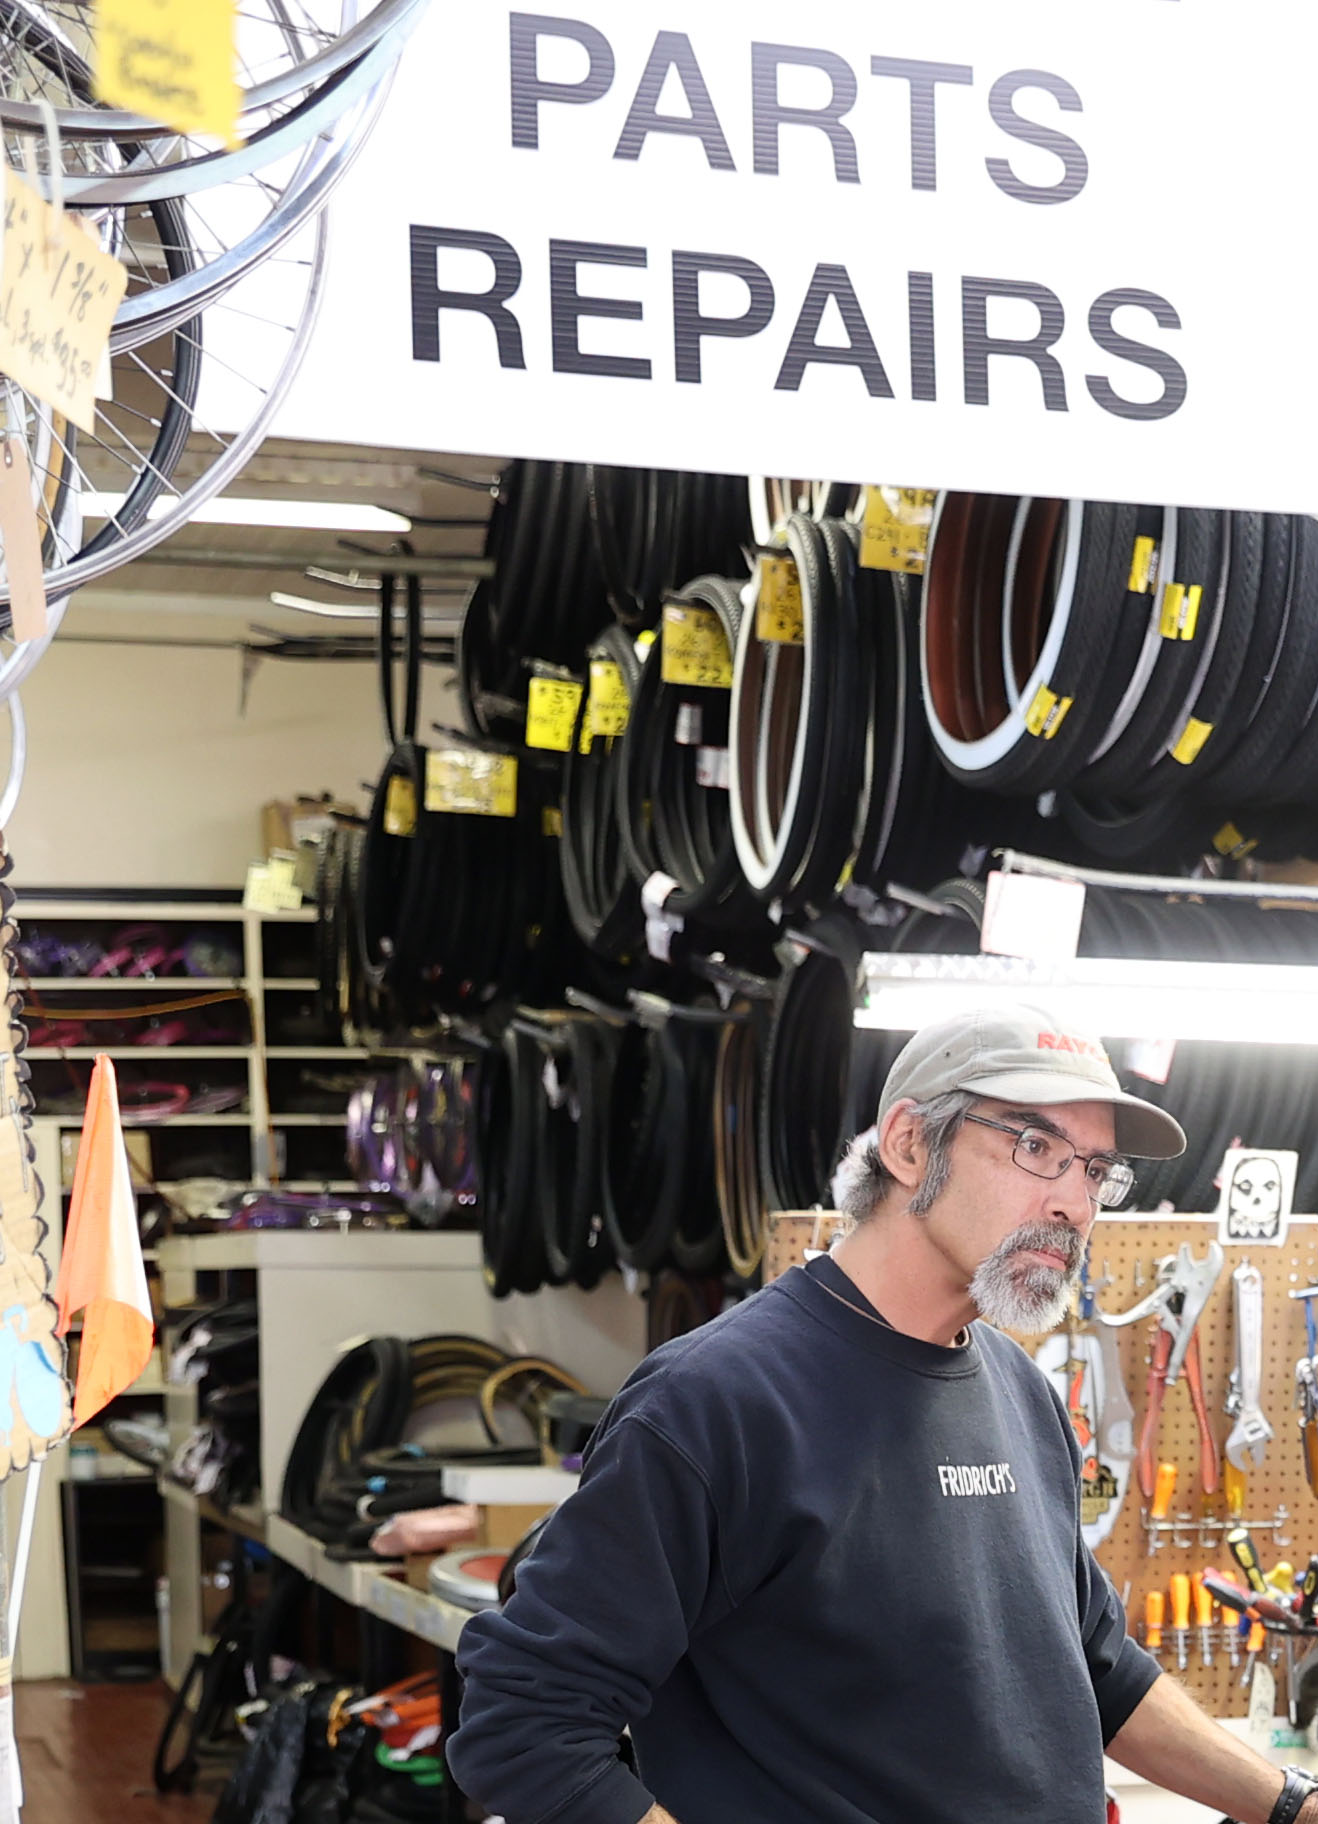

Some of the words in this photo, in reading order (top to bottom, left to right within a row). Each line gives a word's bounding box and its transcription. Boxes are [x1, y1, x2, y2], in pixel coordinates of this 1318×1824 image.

[508, 11, 1090, 206] PARTS
[409, 224, 1189, 422] REPAIRS
[937, 1462, 1017, 1497] FRIDRICH'S
